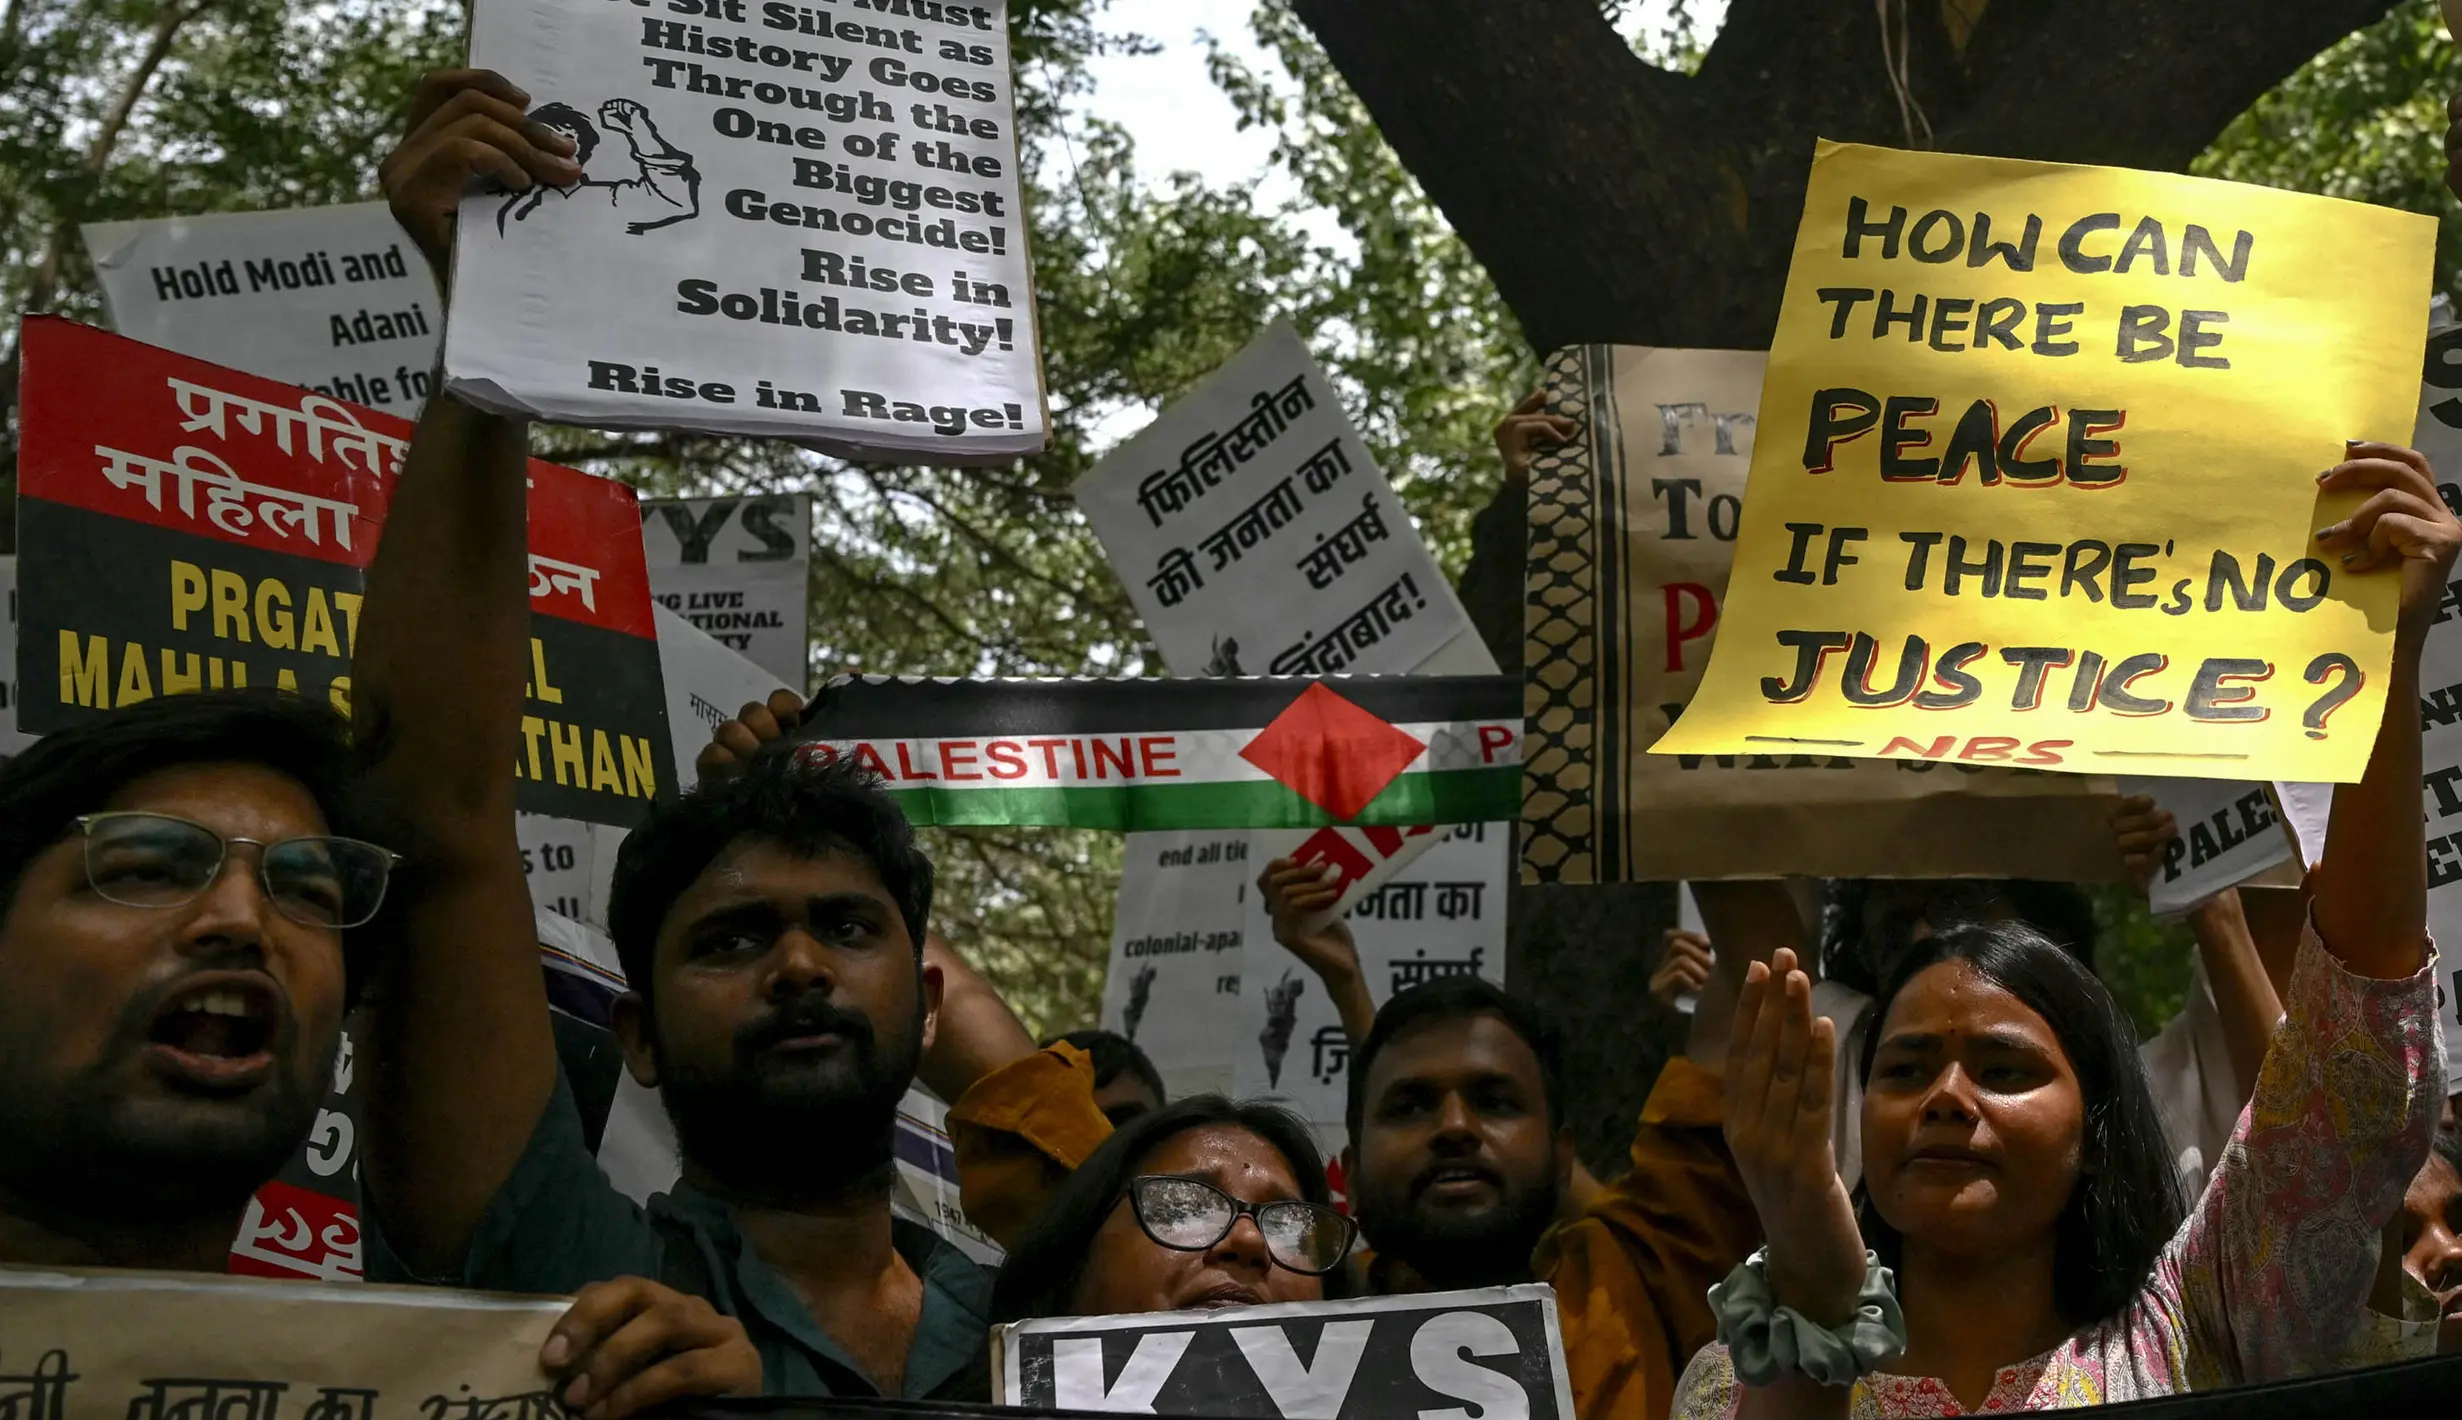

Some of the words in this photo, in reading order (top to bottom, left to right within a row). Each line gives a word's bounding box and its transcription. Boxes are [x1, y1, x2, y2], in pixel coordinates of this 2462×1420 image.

[667, 0, 746, 23] Sit
[762, 1, 923, 54] Silent
[939, 39, 995, 66] as
[852, 0, 993, 31] Must
[641, 17, 852, 83] History
[868, 57, 997, 102] Goes
[643, 57, 895, 123] Through
[910, 103, 999, 140] the
[712, 108, 827, 150] One
[842, 132, 900, 162] of
[911, 140, 1002, 178] the
[793, 157, 1005, 218] Biggest
[724, 189, 1006, 255] Genocide!
[1842, 195, 2042, 272] HOW
[2056, 212, 2254, 283] CAN
[152, 260, 241, 301] Hold
[244, 252, 336, 294] Modi
[341, 244, 408, 283] and
[801, 248, 934, 298] Rise
[951, 270, 1012, 308] in
[330, 303, 430, 348] Adani
[677, 278, 1014, 356] Solidarity!
[1817, 288, 2084, 356] THERE
[2114, 305, 2231, 369] BE
[588, 360, 735, 404] Rise
[756, 380, 821, 414] in
[840, 389, 1024, 436] Rage!
[1137, 373, 1316, 528] फिलिस्तीन
[1802, 388, 2127, 489] PEACE
[95, 444, 359, 551] महिला
[1146, 547, 1205, 608] की
[1198, 477, 1304, 572] जनता
[1296, 436, 1353, 495] का
[641, 500, 796, 564] YS
[1297, 492, 1390, 590] संघर्ष
[688, 592, 744, 610] LIVE
[1773, 522, 1868, 586] IF
[2203, 556, 2331, 613] NO
[1878, 735, 2074, 765] NBS
[540, 843, 575, 872] to
[1158, 844, 1193, 867] end
[1197, 842, 1221, 864] all
[1434, 882, 1486, 920] का
[1124, 930, 1242, 958] colonial-apa
[1053, 1310, 1530, 1420] KYS
